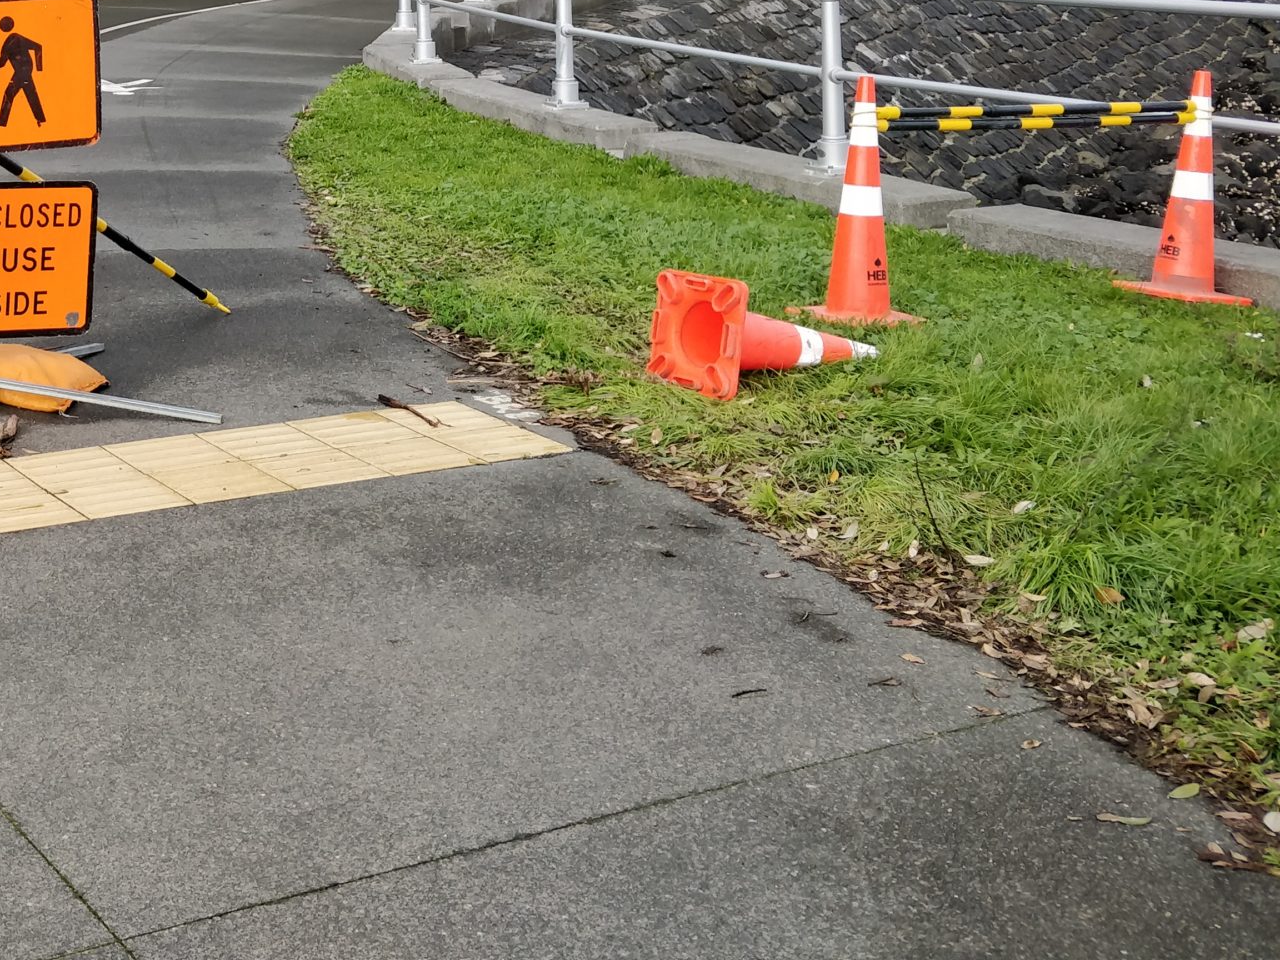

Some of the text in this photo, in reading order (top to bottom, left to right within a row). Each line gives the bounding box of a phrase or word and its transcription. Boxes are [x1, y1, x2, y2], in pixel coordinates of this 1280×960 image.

[1161, 244, 1181, 257] HEB
[2, 247, 56, 272] USE
[867, 270, 887, 281] HEB
